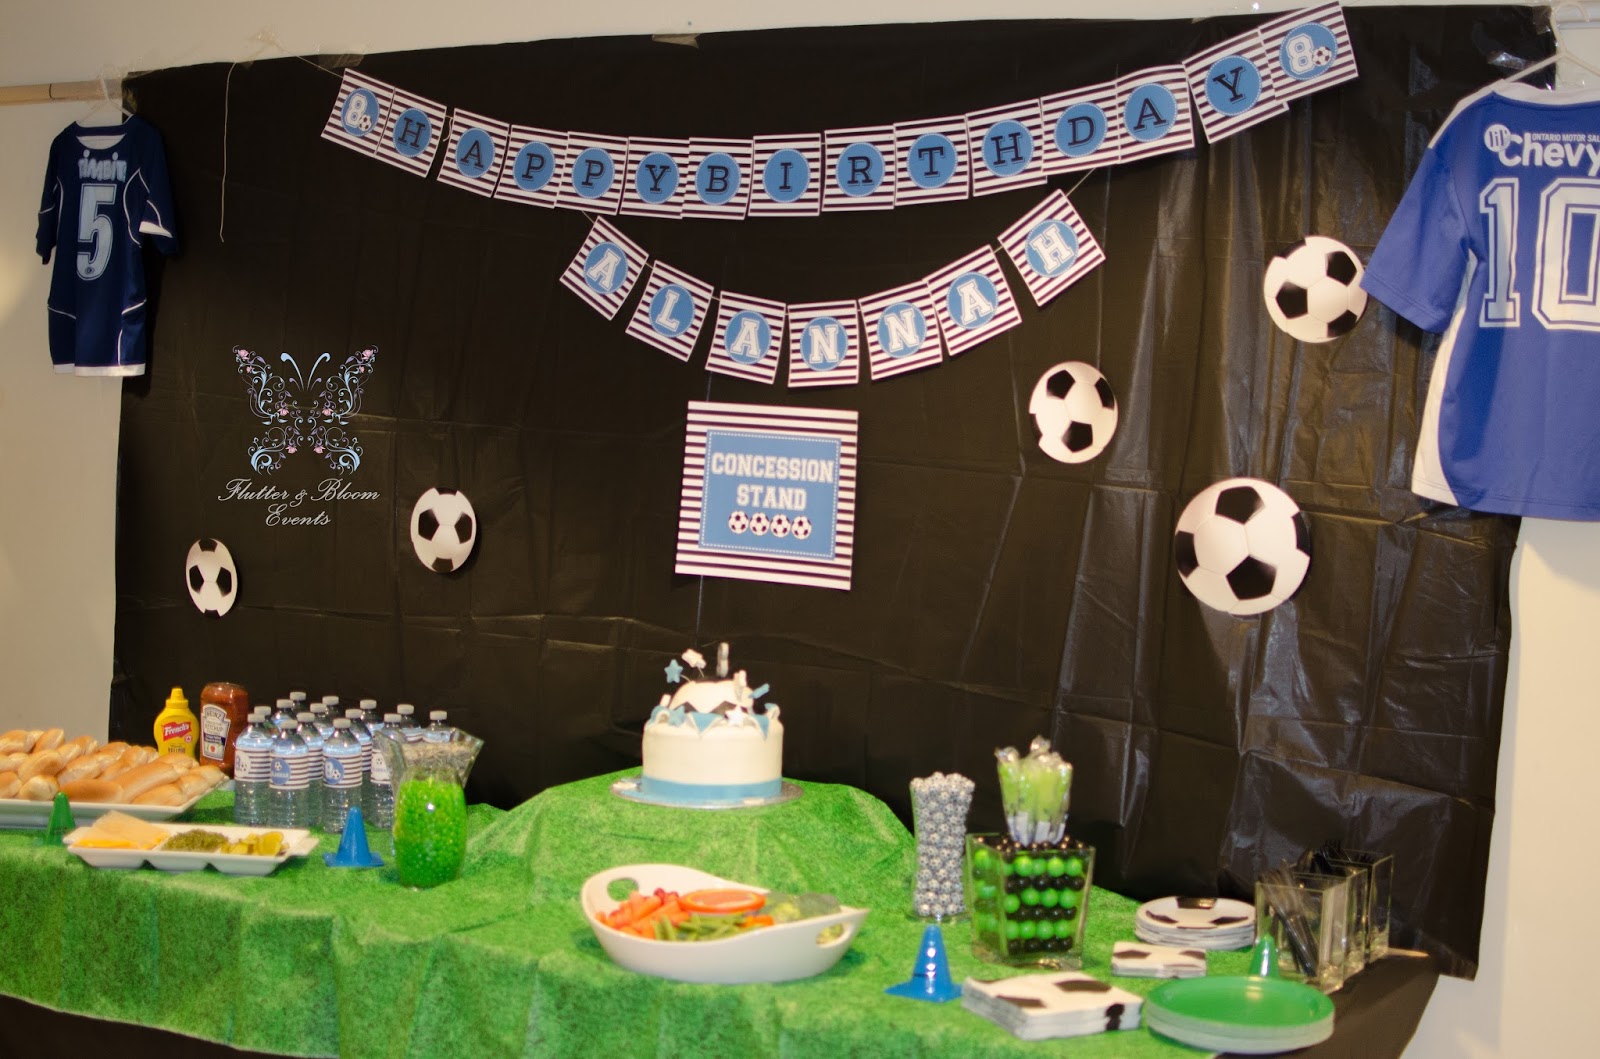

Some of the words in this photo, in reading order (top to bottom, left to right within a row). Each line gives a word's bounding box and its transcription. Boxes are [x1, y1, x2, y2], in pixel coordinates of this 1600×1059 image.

[344, 93, 368, 129] 8
[1285, 33, 1316, 74] 8
[1532, 133, 1560, 142] ONTARIO
[1562, 134, 1585, 142] MOTOR
[1498, 132, 1600, 177] Chevy
[76, 183, 118, 281] 5
[1479, 177, 1600, 332] 10
[711, 452, 835, 484] CONCESSION
[736, 483, 807, 511] STAND
[163, 723, 190, 737] French's
[205, 710, 222, 719] HEINZ
